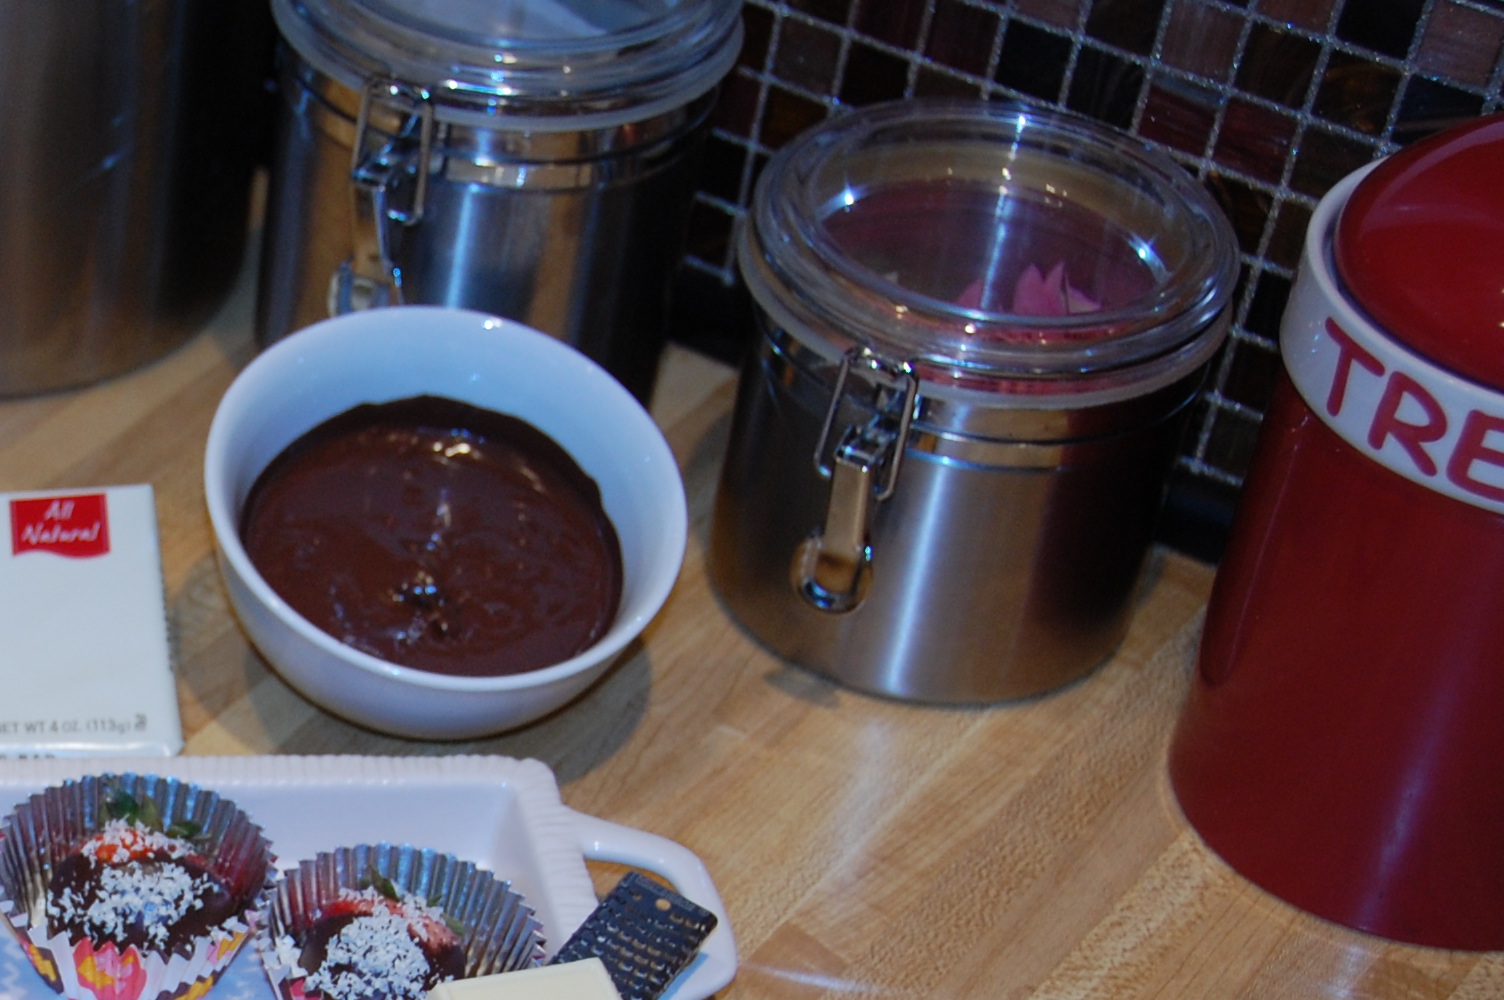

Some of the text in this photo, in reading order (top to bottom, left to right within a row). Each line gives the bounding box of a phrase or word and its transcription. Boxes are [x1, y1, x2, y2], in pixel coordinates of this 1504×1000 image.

[1324, 315, 1504, 503] TRE
[44, 498, 76, 521] All
[21, 520, 102, 545] Natural
[23, 720, 46, 734] WT
[48, 719, 59, 733] 4
[86, 717, 132, 735] (113g)
